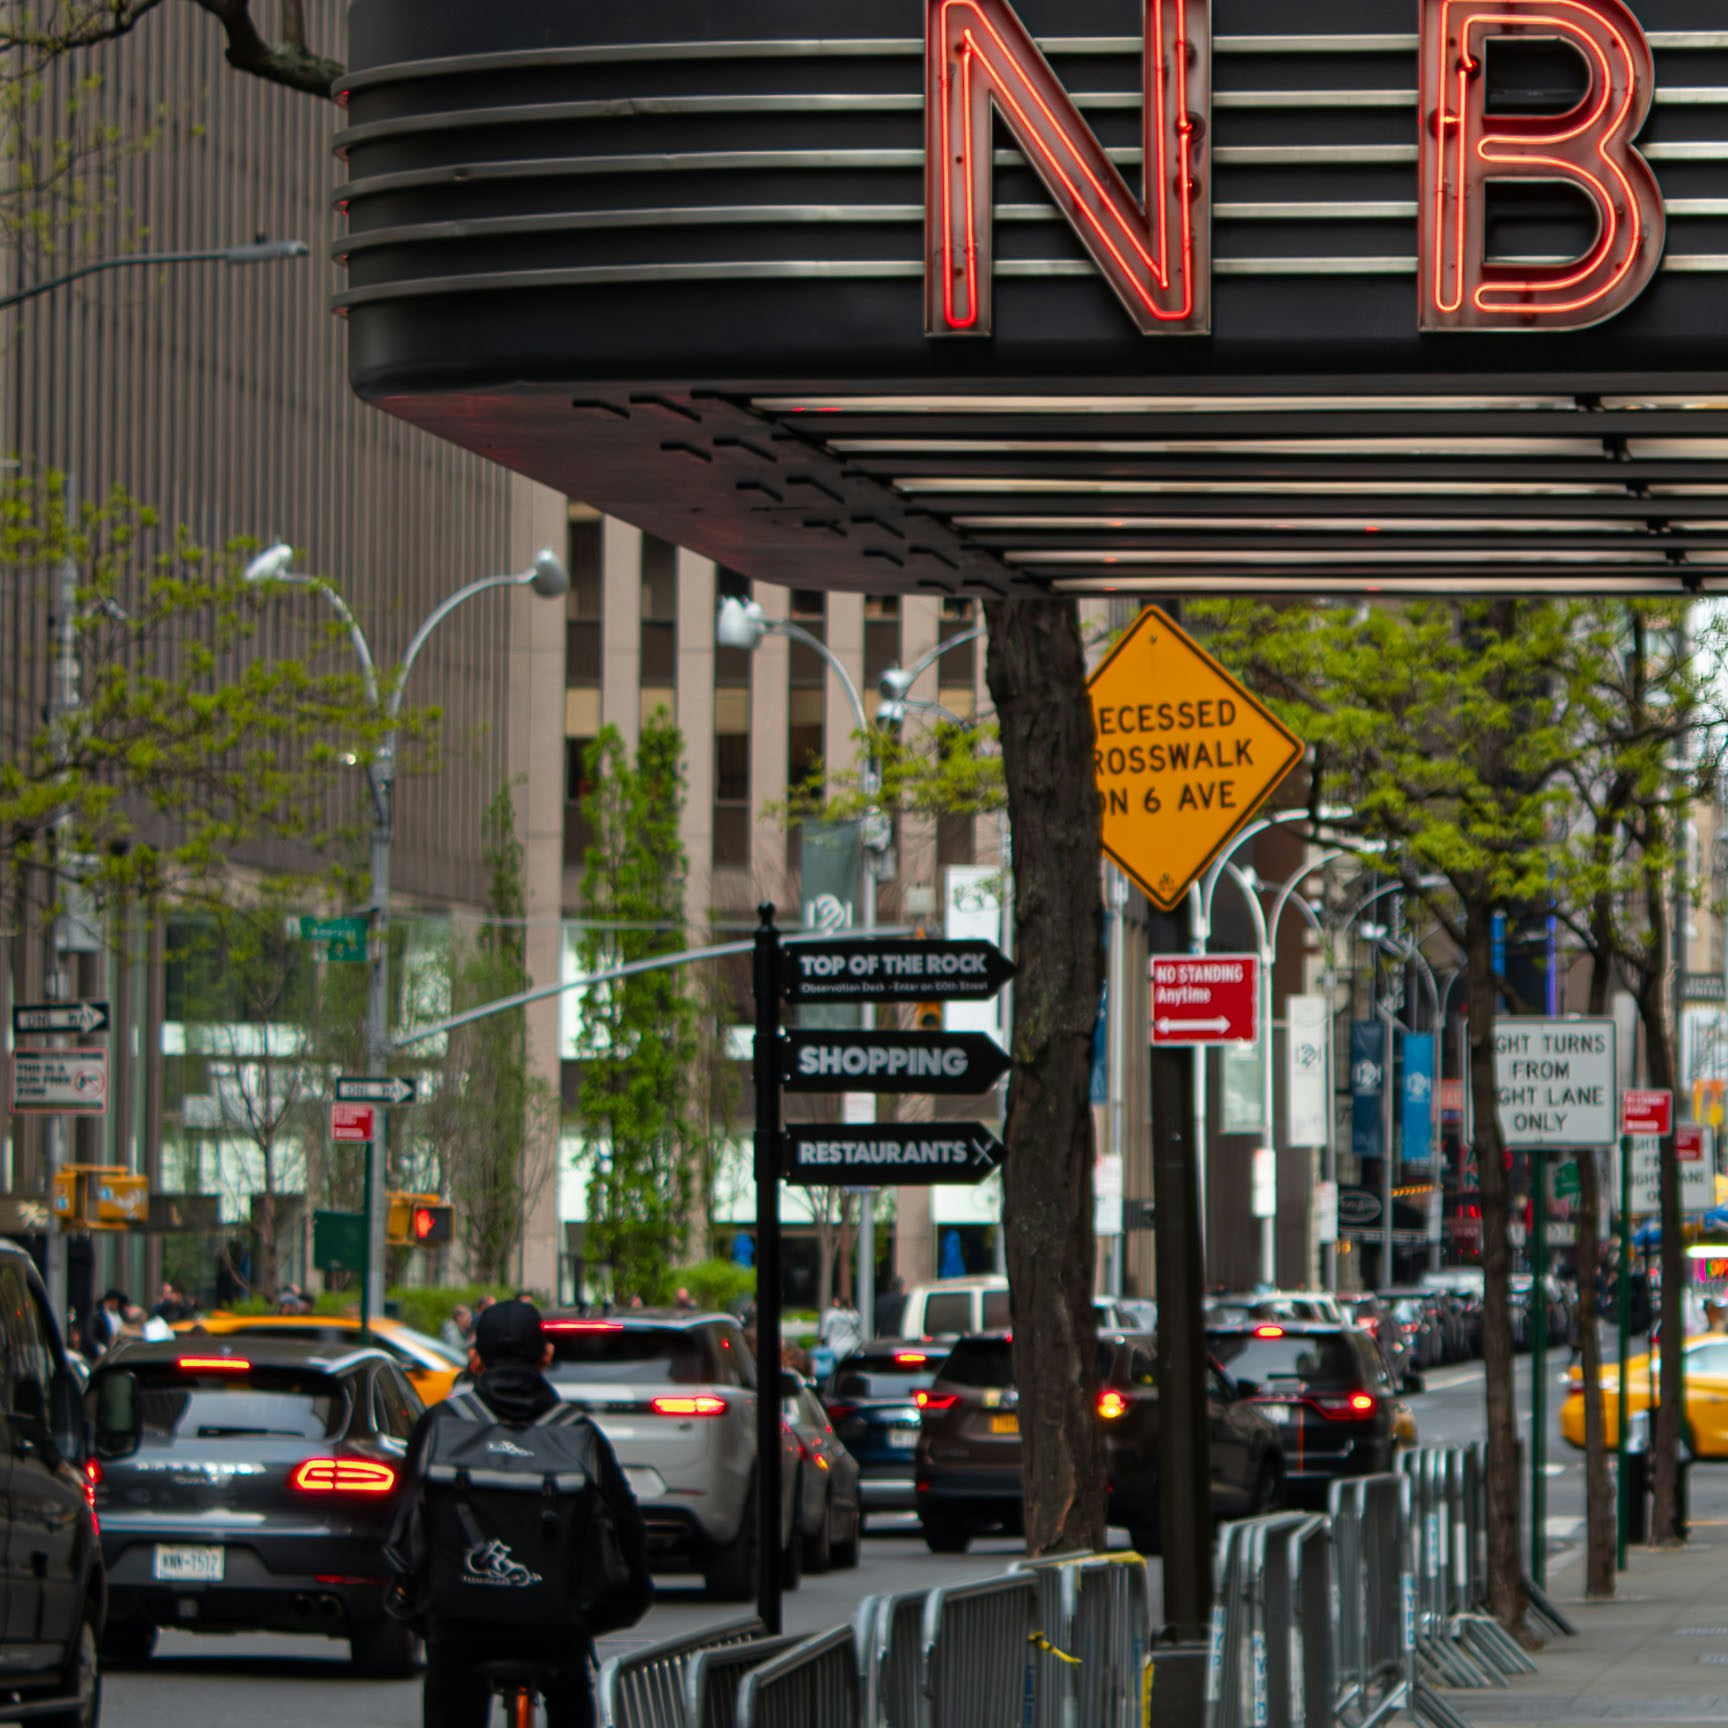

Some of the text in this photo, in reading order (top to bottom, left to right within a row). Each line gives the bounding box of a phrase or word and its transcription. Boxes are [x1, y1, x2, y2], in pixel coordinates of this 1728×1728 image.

[1099, 699, 1238, 736] ECESSED
[1093, 738, 1254, 775] ROSSWALK
[1143, 787, 1162, 814] 6
[1178, 781, 1238, 813] AVE
[800, 953, 988, 976] TOP OF THE ROCK
[1157, 964, 1244, 984] NO STANDING
[801, 982, 861, 994] Observation
[862, 981, 886, 993] Deck
[960, 980, 988, 991] Street
[1157, 986, 1211, 1007] Anytime
[1495, 1033, 1606, 1055] GHT TURNS
[798, 1046, 969, 1076] SHOPPING
[1511, 1060, 1571, 1081] FROM
[1499, 1087, 1605, 1108] GHT LANE
[1514, 1113, 1568, 1132] ONLY
[798, 1141, 968, 1165] RESTAURANTS
